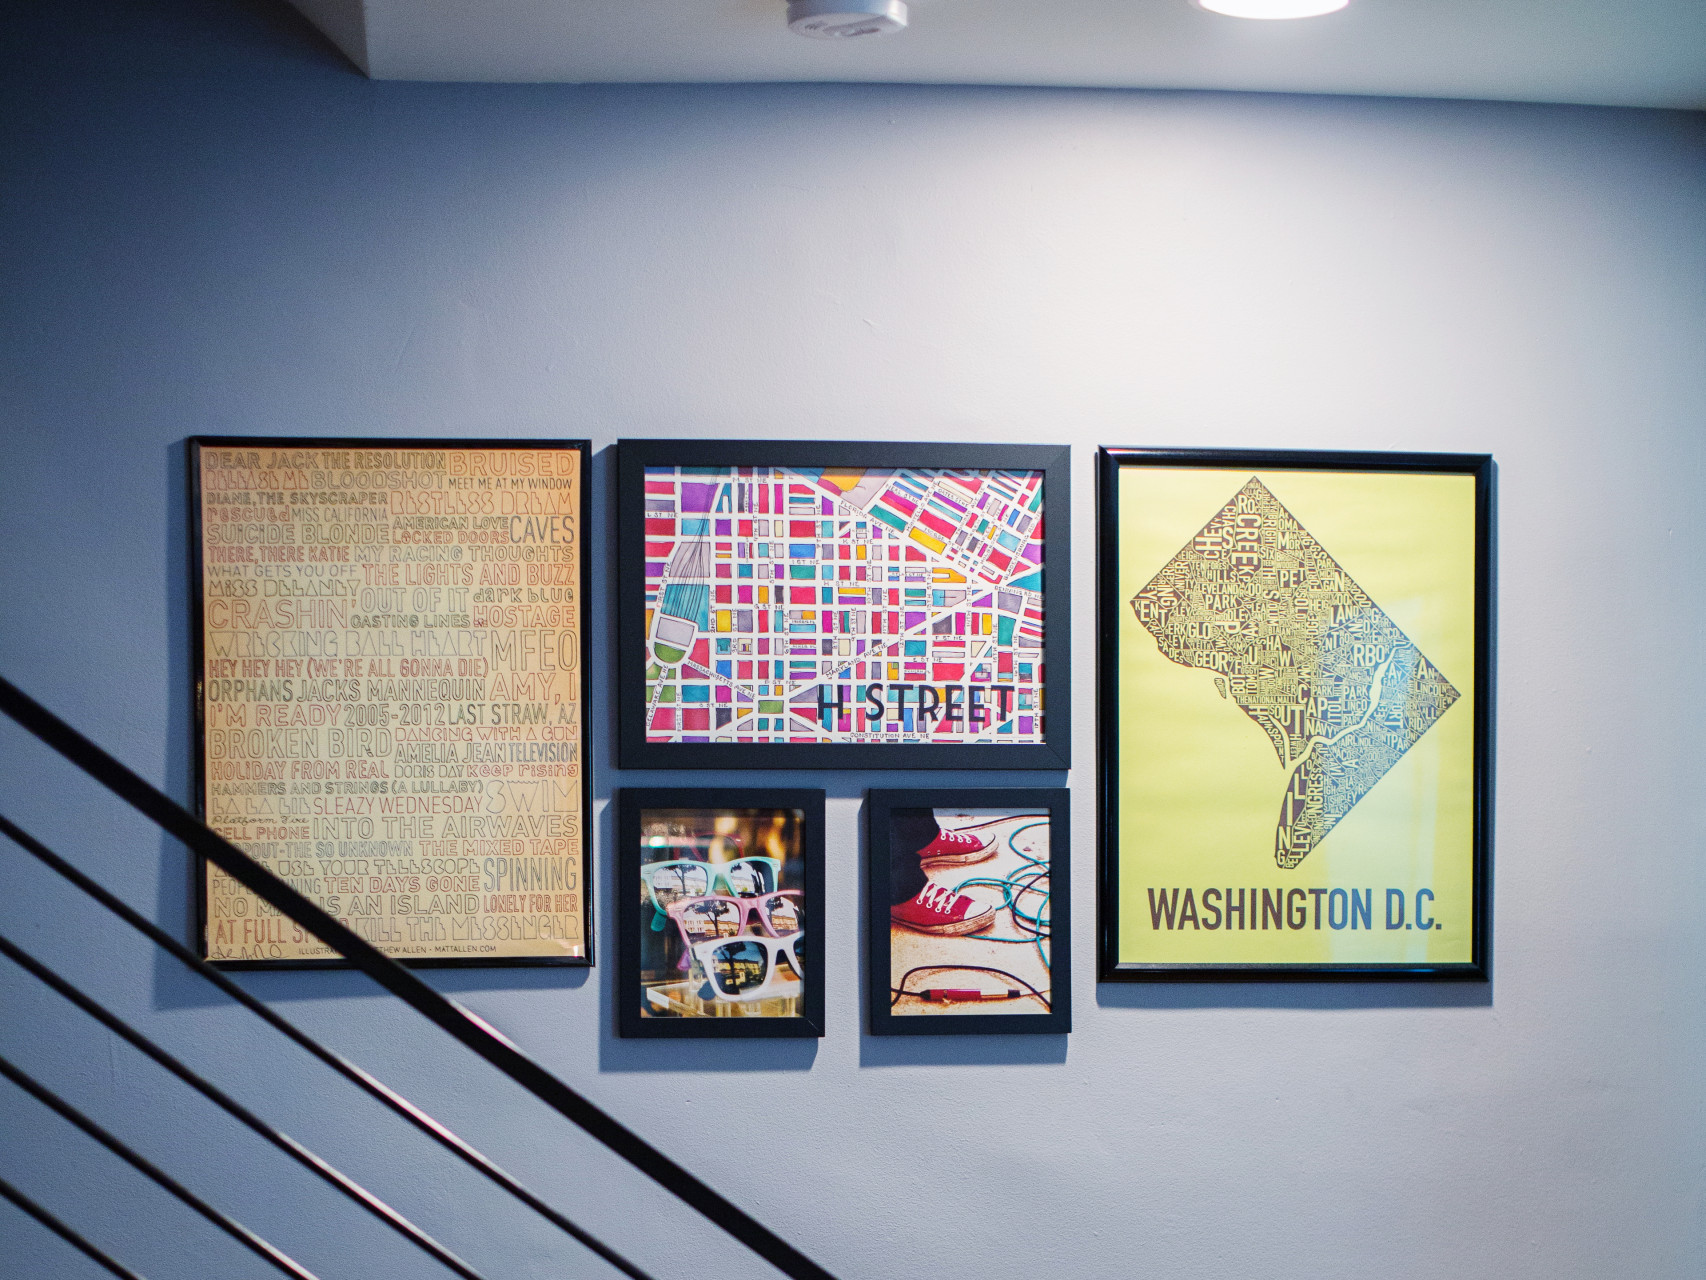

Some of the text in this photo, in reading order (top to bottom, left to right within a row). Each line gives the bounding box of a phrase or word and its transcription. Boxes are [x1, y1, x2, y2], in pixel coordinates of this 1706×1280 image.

[205, 452, 319, 469] DEAR JACK
[322, 452, 446, 470] THE RESOLUTION
[449, 452, 574, 476] BRUISED
[311, 471, 447, 490] BLOODSHOT
[449, 478, 572, 490] MEET ME AT MY WINDOW
[257, 492, 285, 505] THE
[290, 492, 388, 505] SKYSCRAPER
[291, 507, 388, 522] MISS CALIFORNIA
[393, 516, 509, 530] AMERICAN LOVE
[302, 524, 389, 544] BLONDE
[392, 531, 510, 544] LOCKED DOORS
[510, 515, 574, 544] CAVES
[259, 546, 304, 563] THERE
[354, 546, 463, 562] MY RACING
[468, 546, 574, 562] THOUGHTS
[207, 565, 357, 577] WHAT GETS YOU OFF
[362, 563, 575, 586] THE LIGHTS AND BUZZ
[361, 587, 469, 613] OUT OF IT
[208, 599, 357, 629] CRASHIN'
[350, 614, 470, 628] CASTING LINES
[473, 605, 575, 628] HOSTAGE
[346, 631, 404, 657] BALL
[491, 630, 577, 671] MFEO
[209, 659, 237, 678] HEY
[242, 659, 271, 678] HEY
[275, 659, 303, 678] HEY
[368, 659, 395, 678] ALL
[400, 658, 453, 677] GONNA
[458, 657, 488, 678] DIE)
[208, 679, 293, 702] ORPHANS
[297, 679, 485, 702] JACKS MANNEQUIN
[490, 673, 576, 705] AMY, I
[817, 684, 843, 720] H
[865, 682, 1015, 723] STREET
[210, 704, 341, 727] I'M READY
[343, 703, 445, 726] 2005-2012
[449, 703, 485, 725] LAST
[558, 703, 577, 724] AZ
[210, 728, 392, 759] BROKEN BIRD
[394, 743, 507, 763] AMELIA JEAN
[508, 742, 577, 762] TELEVISION
[291, 760, 340, 780] FROM
[346, 760, 389, 779] REAL
[394, 765, 464, 778] DORIS DAY
[211, 780, 483, 795] HAMMERS AND STRINGS (A LULLABY)
[486, 780, 578, 814] SWIM
[313, 796, 483, 815] SLEAZY WEDNESDAY
[256, 826, 310, 840] PHONE
[313, 815, 578, 840] INTO THE AIRWAVES
[316, 841, 335, 859] SO
[338, 840, 413, 859] UNKNOWN
[419, 838, 579, 857] THE MIXED TAPE
[319, 860, 369, 875] YOUR
[484, 857, 577, 892] SPINNING
[324, 876, 480, 894] TEN DAYS GONE
[215, 897, 248, 918] NO
[348, 896, 382, 916] AN
[391, 894, 480, 915] ISLAND
[484, 894, 578, 913] LONELY FOR HER
[1147, 888, 1442, 930] WASHINGTON D.C.
[216, 920, 237, 944] AT
[244, 919, 286, 944] FULL
[402, 946, 427, 954] ALLEN
